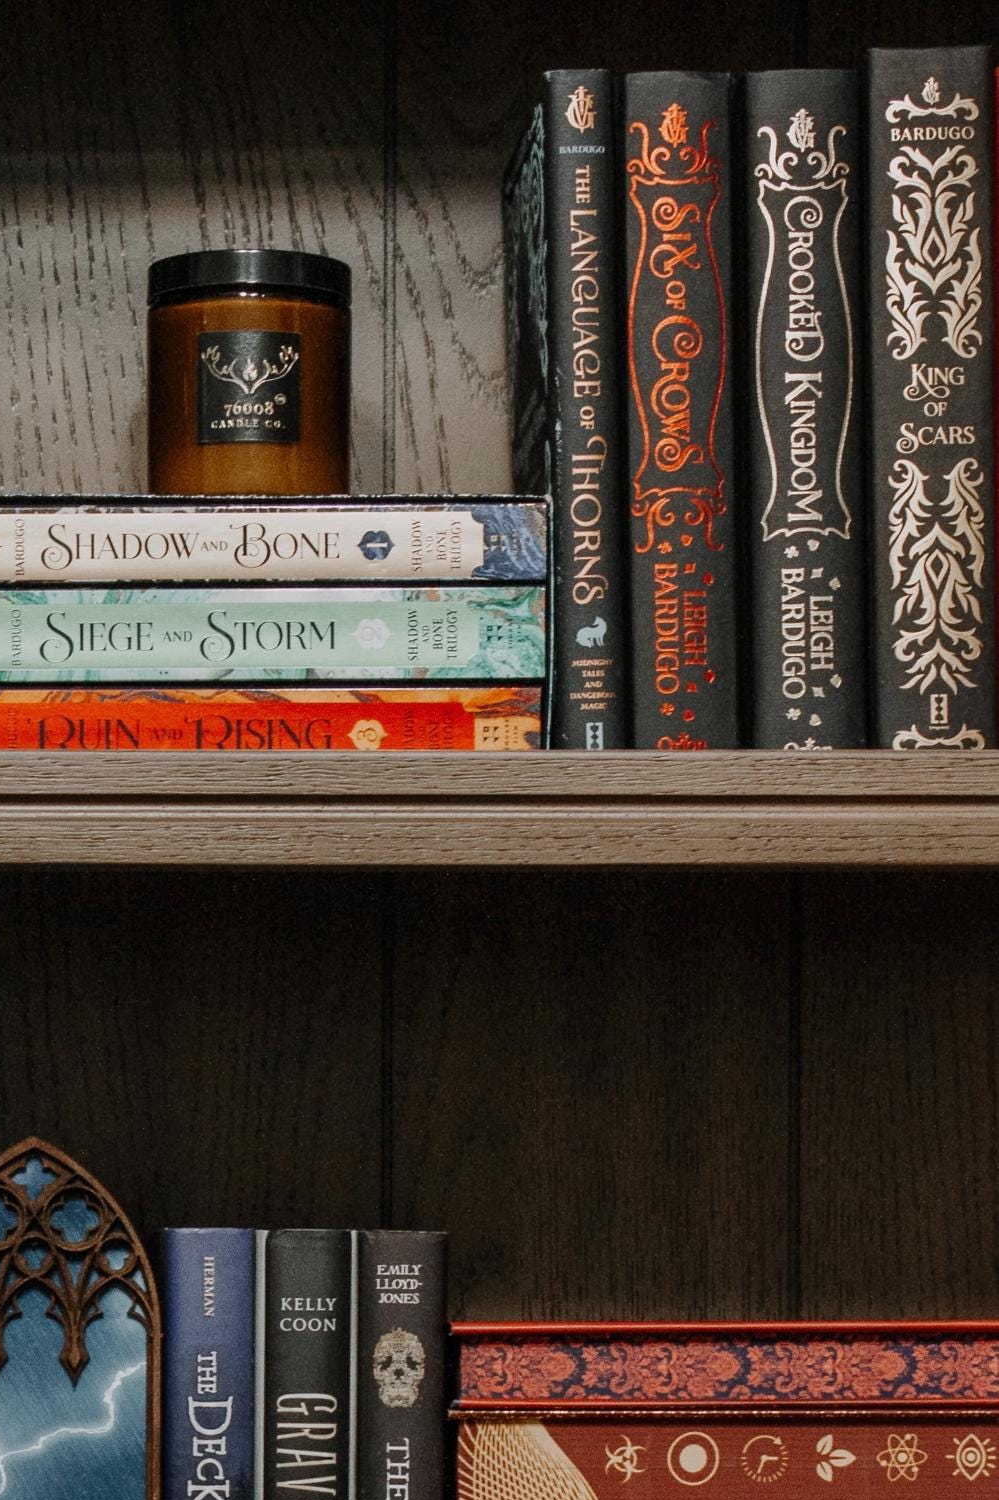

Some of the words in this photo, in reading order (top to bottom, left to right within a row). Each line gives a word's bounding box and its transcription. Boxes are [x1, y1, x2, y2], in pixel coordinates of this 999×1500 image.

[558, 144, 606, 155] BARDUGO
[890, 126, 976, 143] BARDUGO
[575, 164, 592, 205] THE
[665, 281, 687, 311] OF
[783, 195, 826, 363] CROOKED
[570, 208, 602, 399] LANGUAGE
[651, 314, 705, 473] CROWS
[923, 400, 948, 417] OF
[210, 418, 261, 429] CANDLE
[579, 404, 595, 430] OF
[894, 420, 976, 454] SCARS
[784, 371, 824, 524] KINGDOM
[571, 434, 608, 606] THORNS
[15, 518, 26, 577] BARDUGO
[40, 523, 200, 571] SHADOW
[200, 540, 229, 552] AND
[229, 522, 341, 568] BONE
[411, 518, 422, 573] SHADOW
[426, 534, 435, 555] AND
[436, 528, 448, 561] BONE
[450, 519, 462, 571] TRILOGY
[11, 608, 22, 667] BARDUGO
[39, 610, 154, 664] SIEGE
[162, 630, 193, 643] AND
[199, 609, 337, 663] STORM
[407, 608, 419, 662] SHADOW
[422, 624, 431, 644] AND
[433, 617, 445, 650] BONE
[446, 607, 459, 660] TRILOGY
[653, 562, 681, 695] BARDUGO
[682, 590, 708, 667] LEIGH
[780, 568, 808, 699] BARDUGO
[810, 594, 835, 671] LEIGH
[203, 1256, 216, 1318] HERMAN
[376, 1264, 421, 1276] EMILY
[376, 1278, 423, 1290] LLOYD-
[280, 1297, 337, 1312] KELLY
[378, 1292, 420, 1305] JONES
[279, 1317, 337, 1332] COON
[196, 1351, 218, 1394] THE
